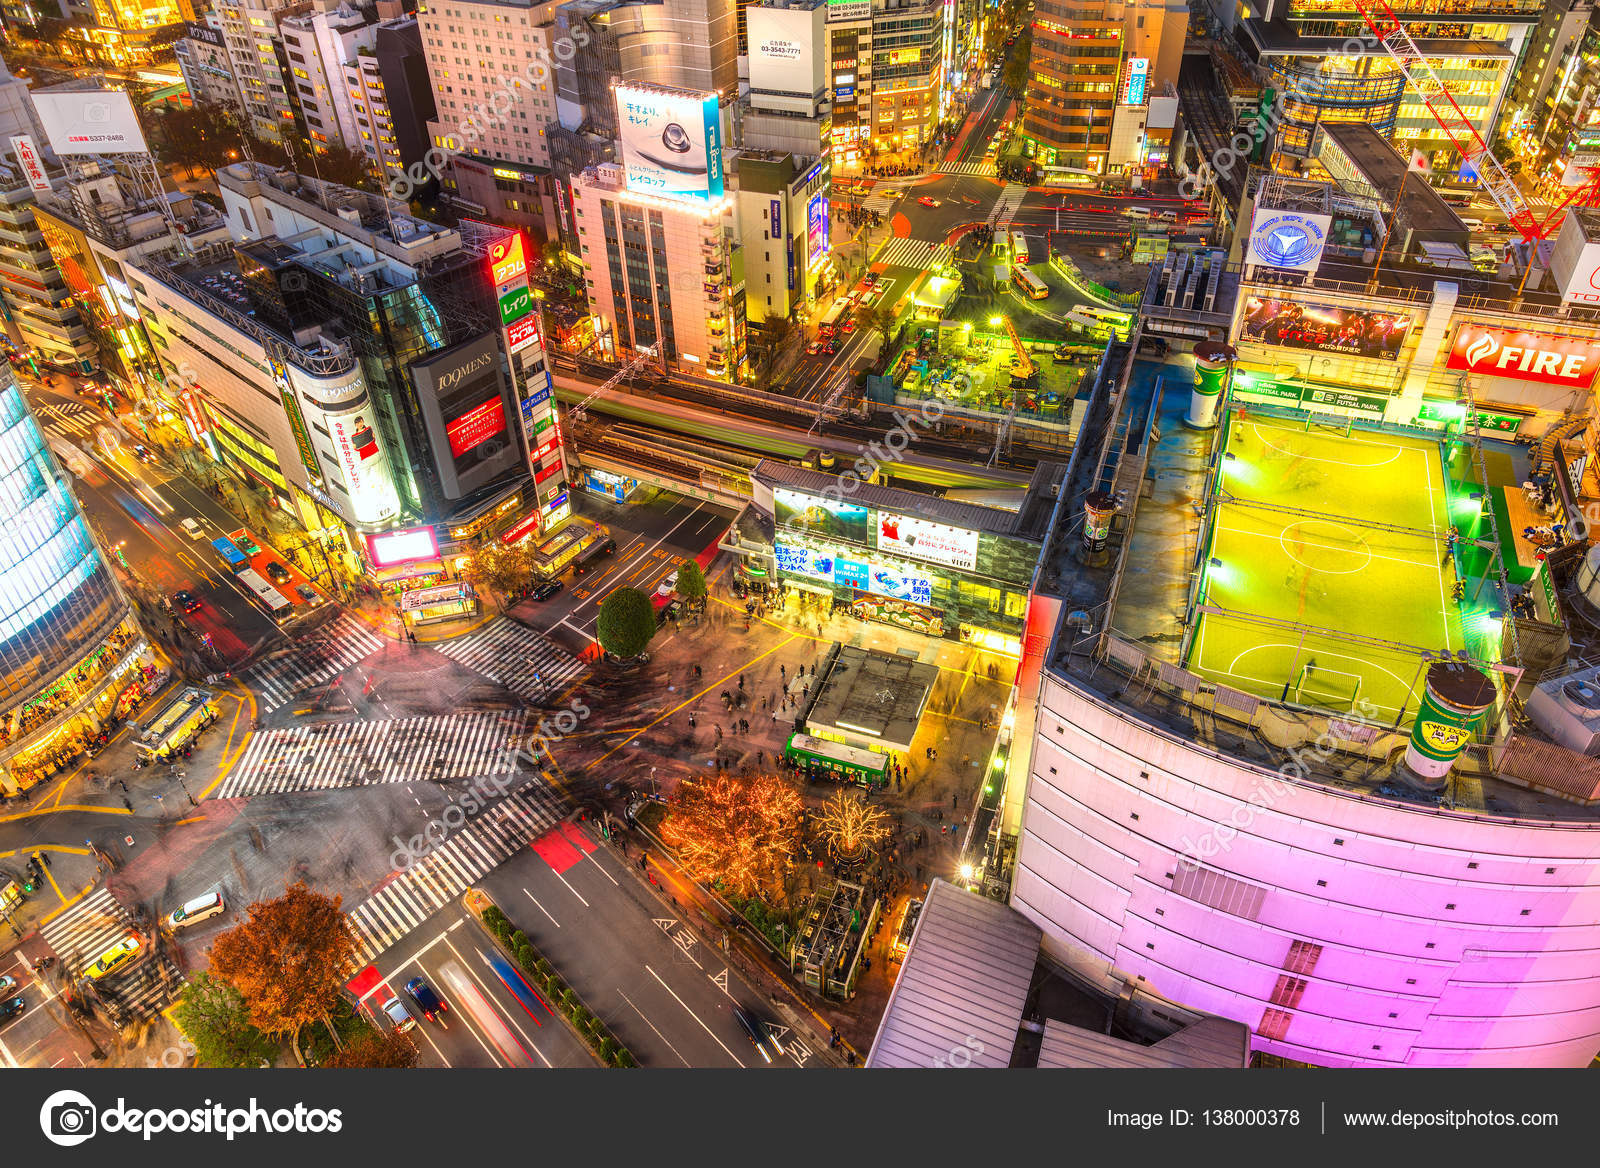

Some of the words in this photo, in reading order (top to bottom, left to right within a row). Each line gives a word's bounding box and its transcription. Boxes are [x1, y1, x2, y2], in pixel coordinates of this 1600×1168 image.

[629, 172, 667, 188] レイコップ
[496, 260, 526, 281] アコム
[503, 293, 529, 316] レイク
[1496, 345, 1588, 379] FIRE
[774, 546, 808, 557] 日本一の
[776, 554, 807, 564] モバイル
[111, 643, 147, 680] TSUTAYA
[1424, 722, 1446, 732] TWO
